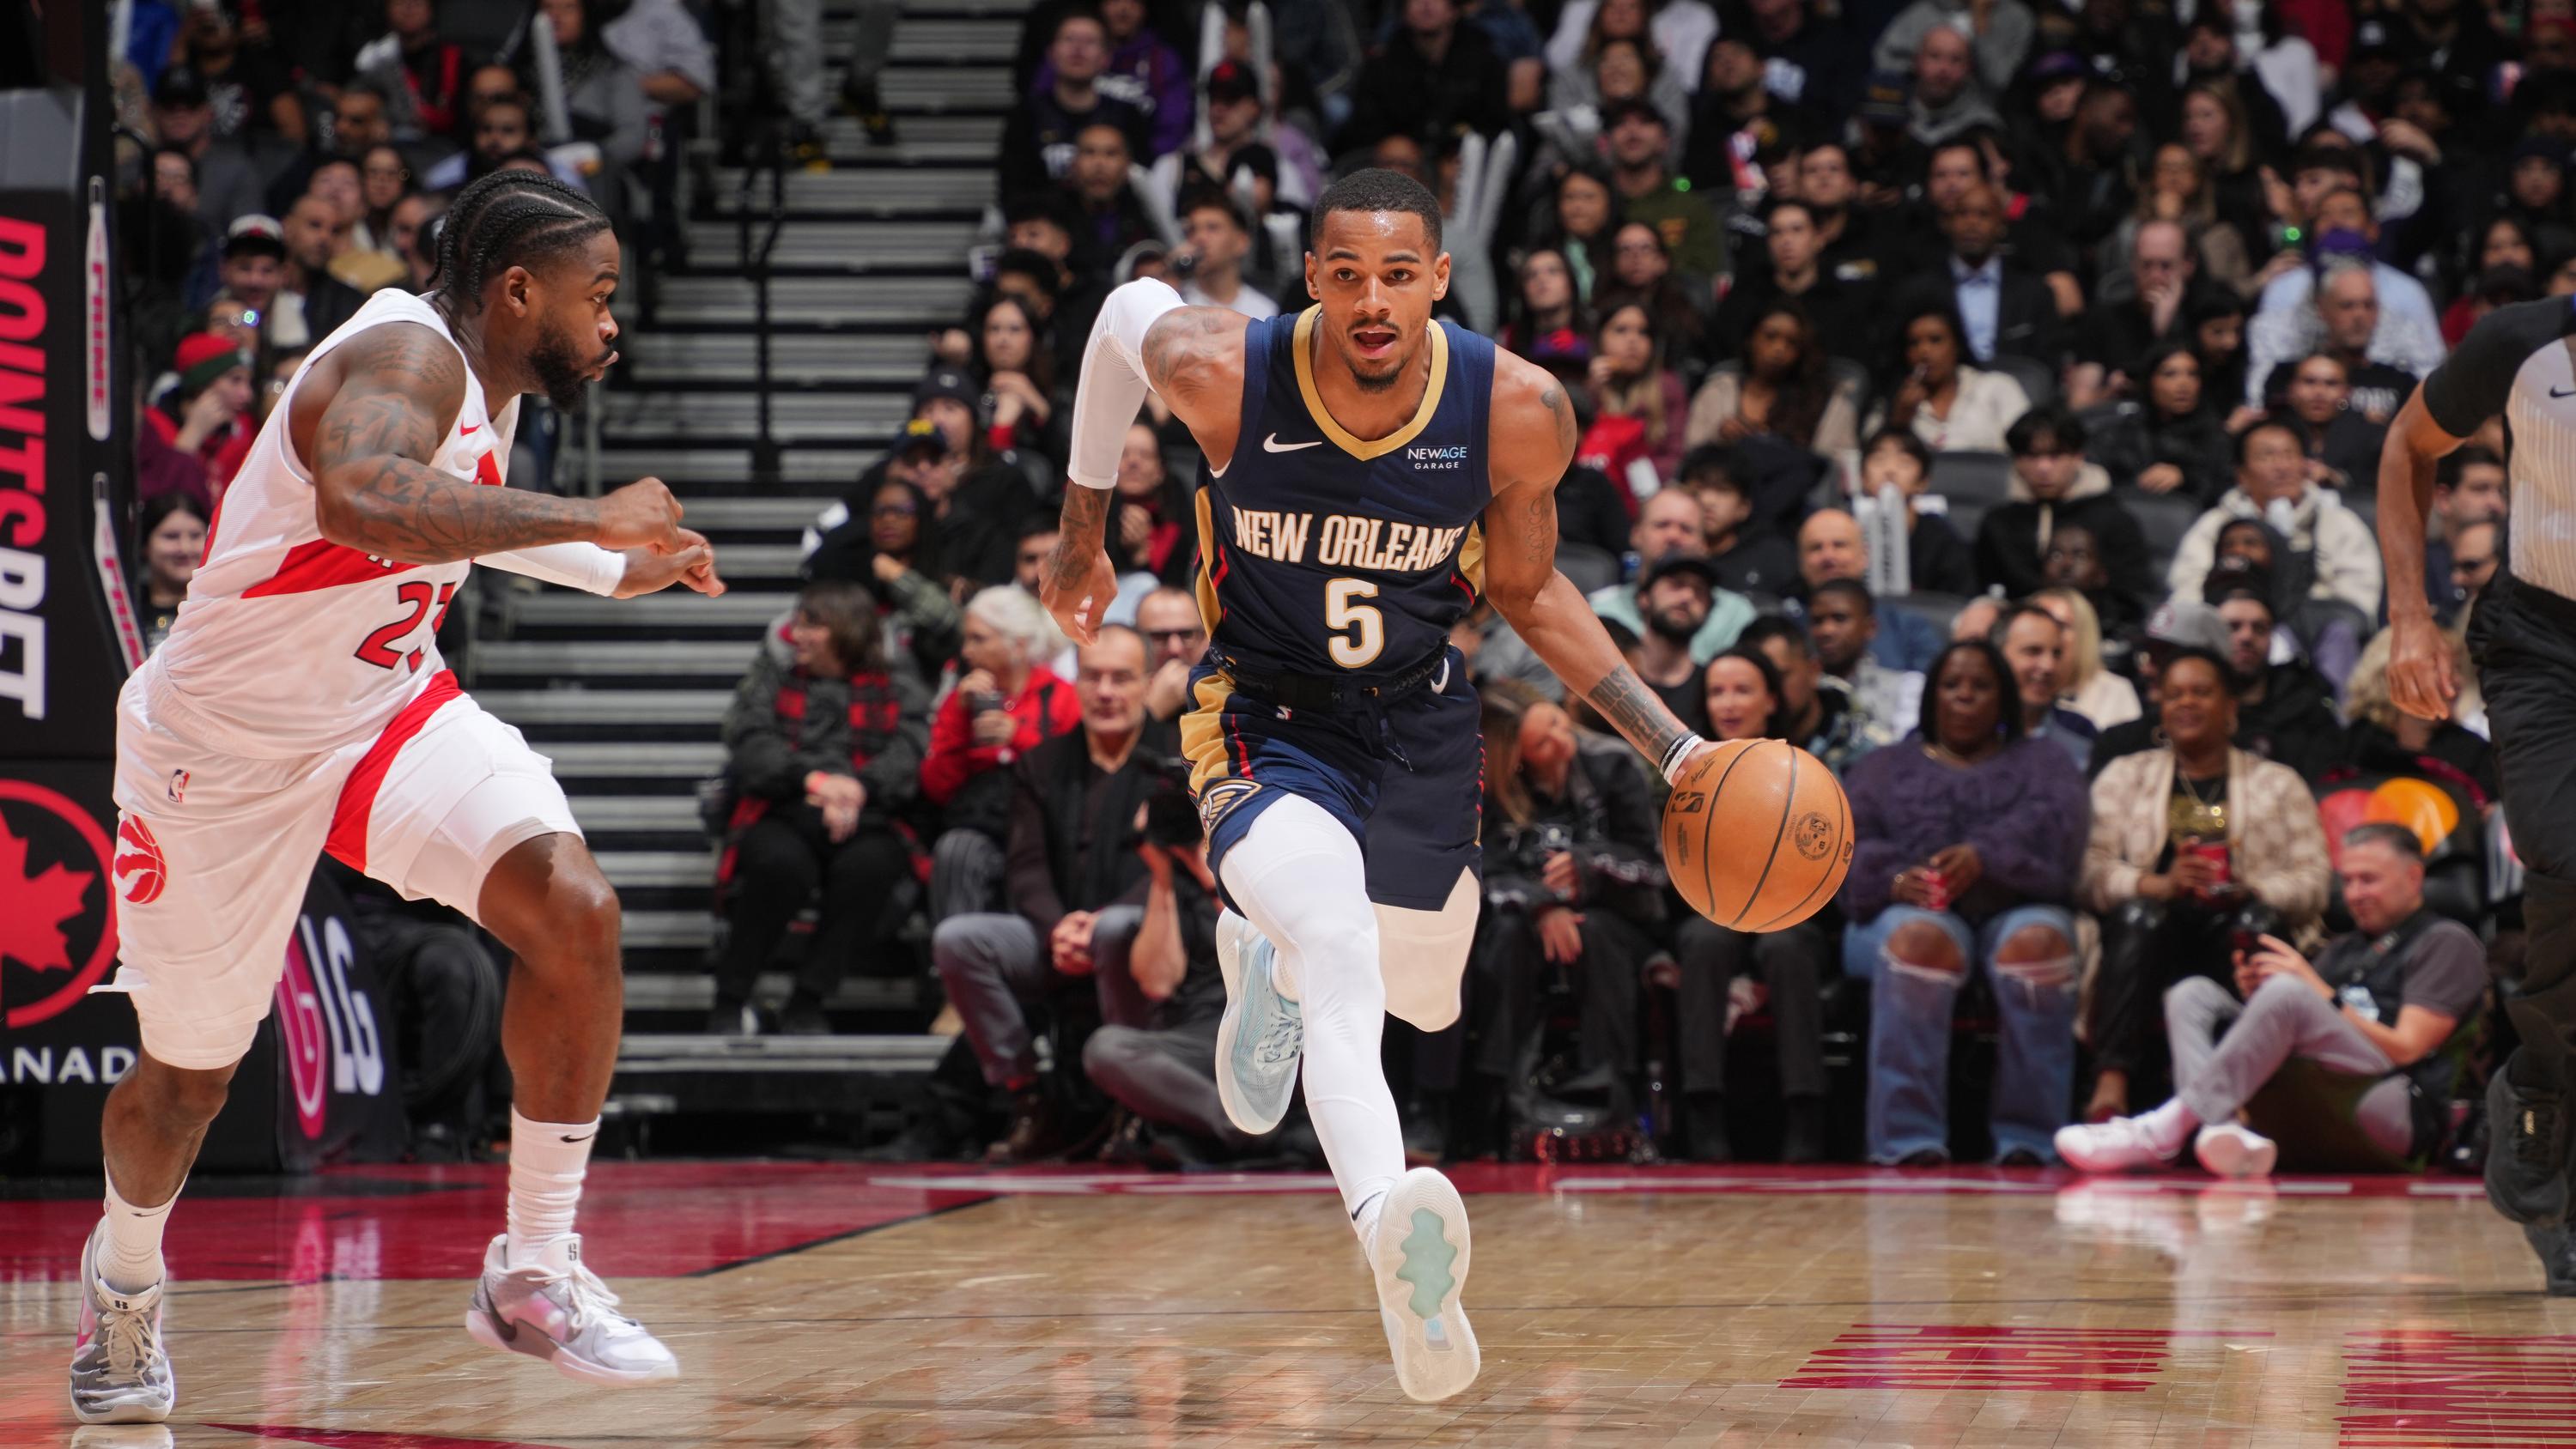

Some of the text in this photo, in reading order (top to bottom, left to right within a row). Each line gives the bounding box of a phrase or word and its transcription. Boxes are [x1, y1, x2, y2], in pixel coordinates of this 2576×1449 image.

[1407, 446, 1467, 460] NEWAGE
[1414, 461, 1459, 470] GARAGE
[1231, 505, 1313, 563] NEW
[1318, 515, 1464, 572] ORLEANS
[1325, 577, 1384, 669] 5
[300, 914, 383, 1096] LG
